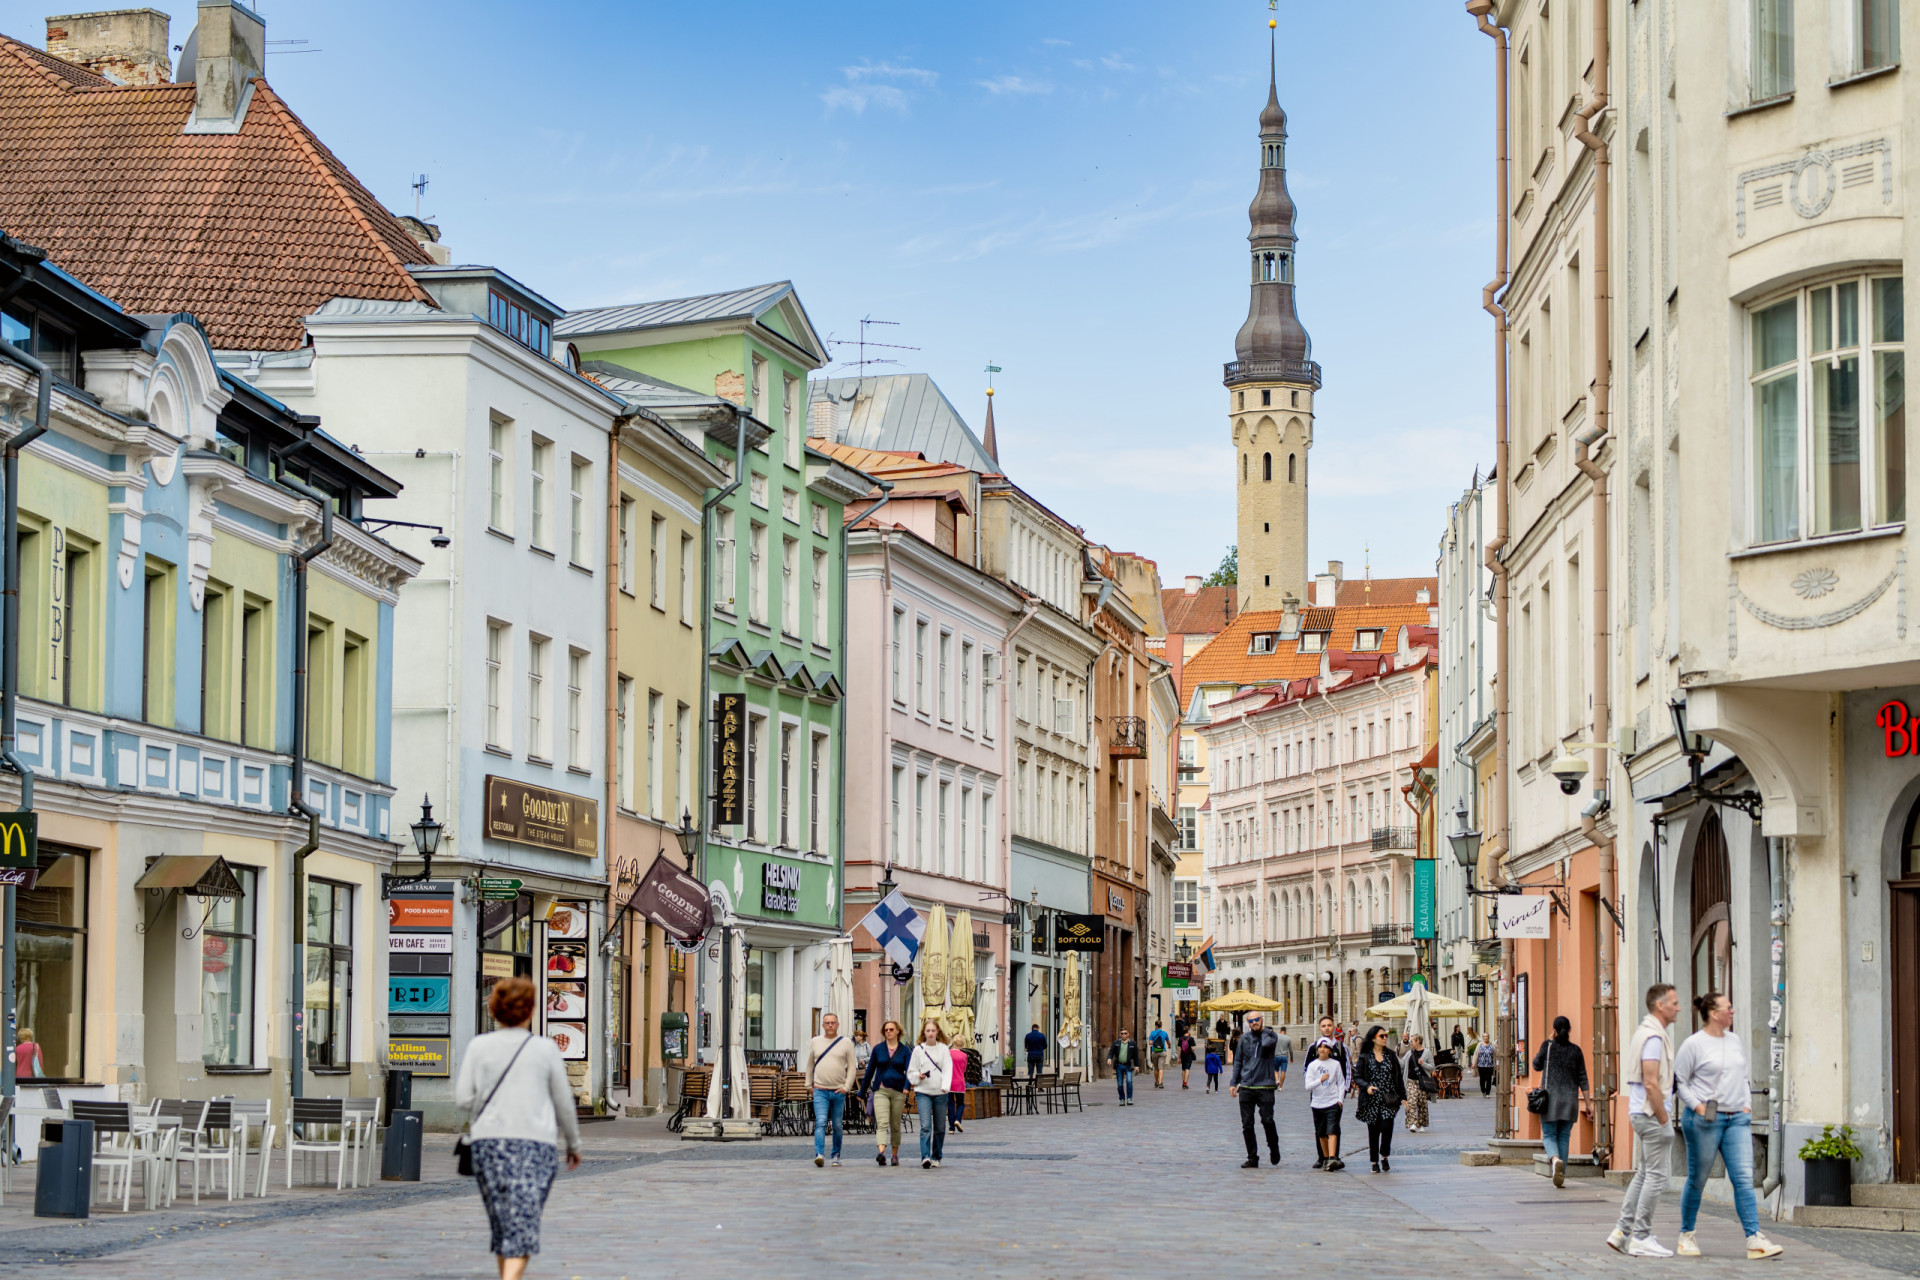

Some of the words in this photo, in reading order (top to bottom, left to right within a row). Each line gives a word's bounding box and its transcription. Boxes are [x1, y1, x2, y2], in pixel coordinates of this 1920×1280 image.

[51, 526, 64, 680] PUBI
[1876, 700, 1920, 758] Br
[722, 696, 738, 822] PAPARAZZI
[522, 792, 570, 825] GOODWIN
[493, 820, 514, 833] RESTORAN
[528, 828, 536, 836] THE
[536, 829, 550, 840] STEAK
[550, 832, 564, 843] HOUSE
[578, 838, 595, 848] RESTORAN
[766, 862, 800, 890] HELSINKI
[658, 883, 702, 919] GOODWI
[766, 886, 786, 910] karaoke
[788, 888, 800, 912] baar
[406, 938, 424, 948] CAFE
